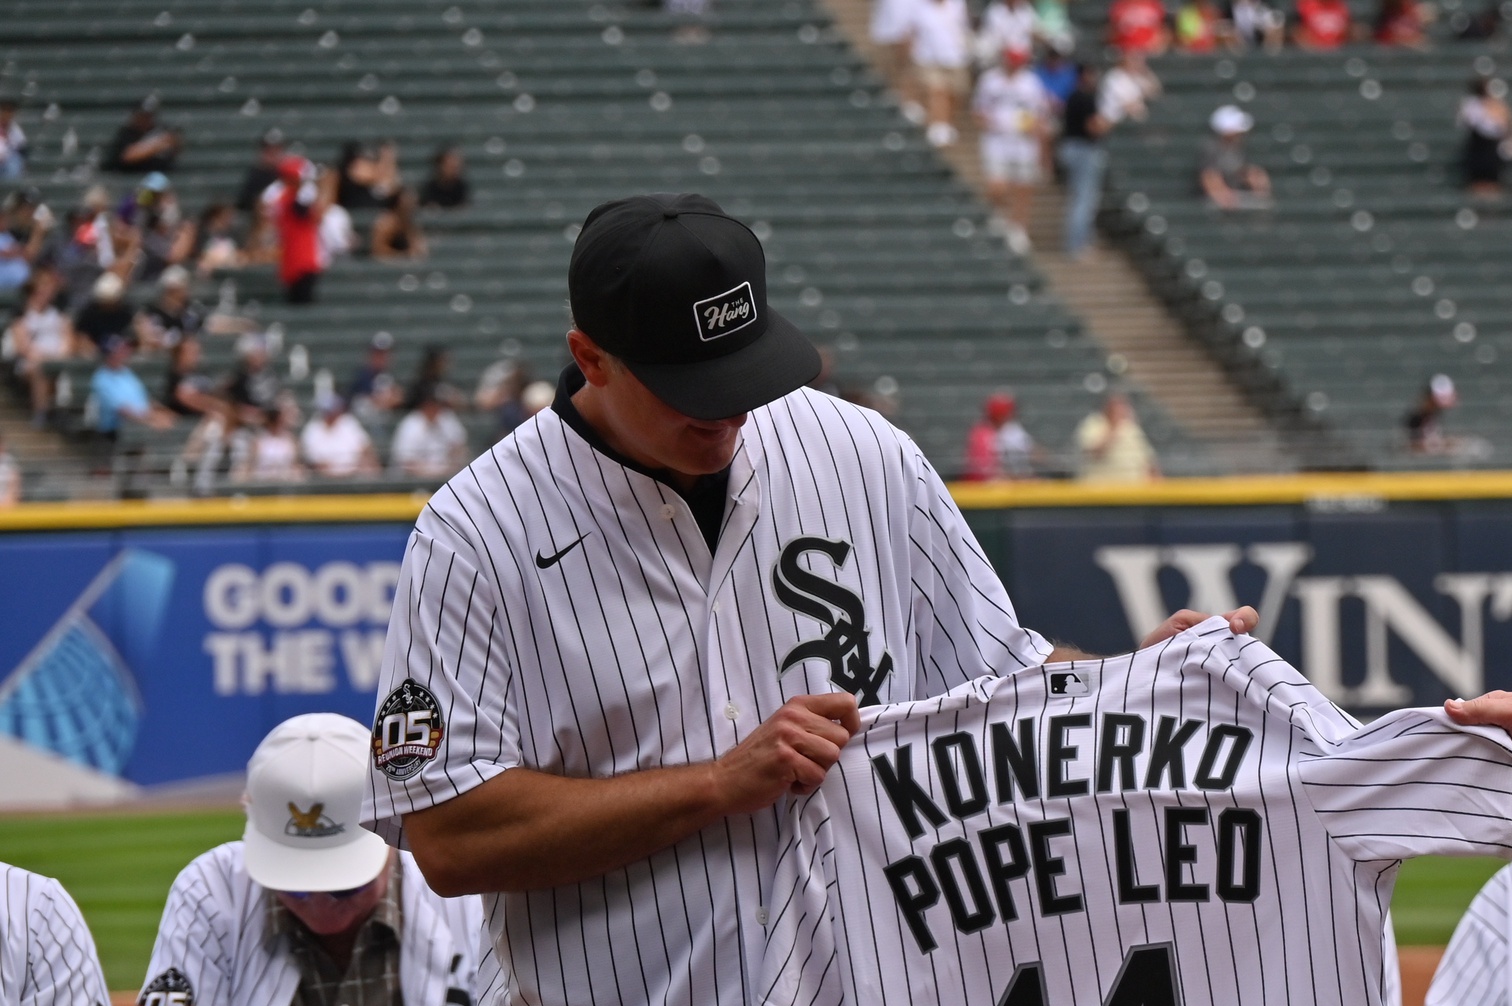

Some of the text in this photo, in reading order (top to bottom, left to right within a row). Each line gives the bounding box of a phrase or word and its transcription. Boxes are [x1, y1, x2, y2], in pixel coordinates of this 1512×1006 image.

[703, 302, 750, 330] Hang
[206, 632, 333, 694] THE
[382, 711, 432, 752] 05
[403, 745, 433, 757] WEEKEND
[870, 712, 1254, 841] KONERKO
[883, 806, 1263, 955] POPE LEO
